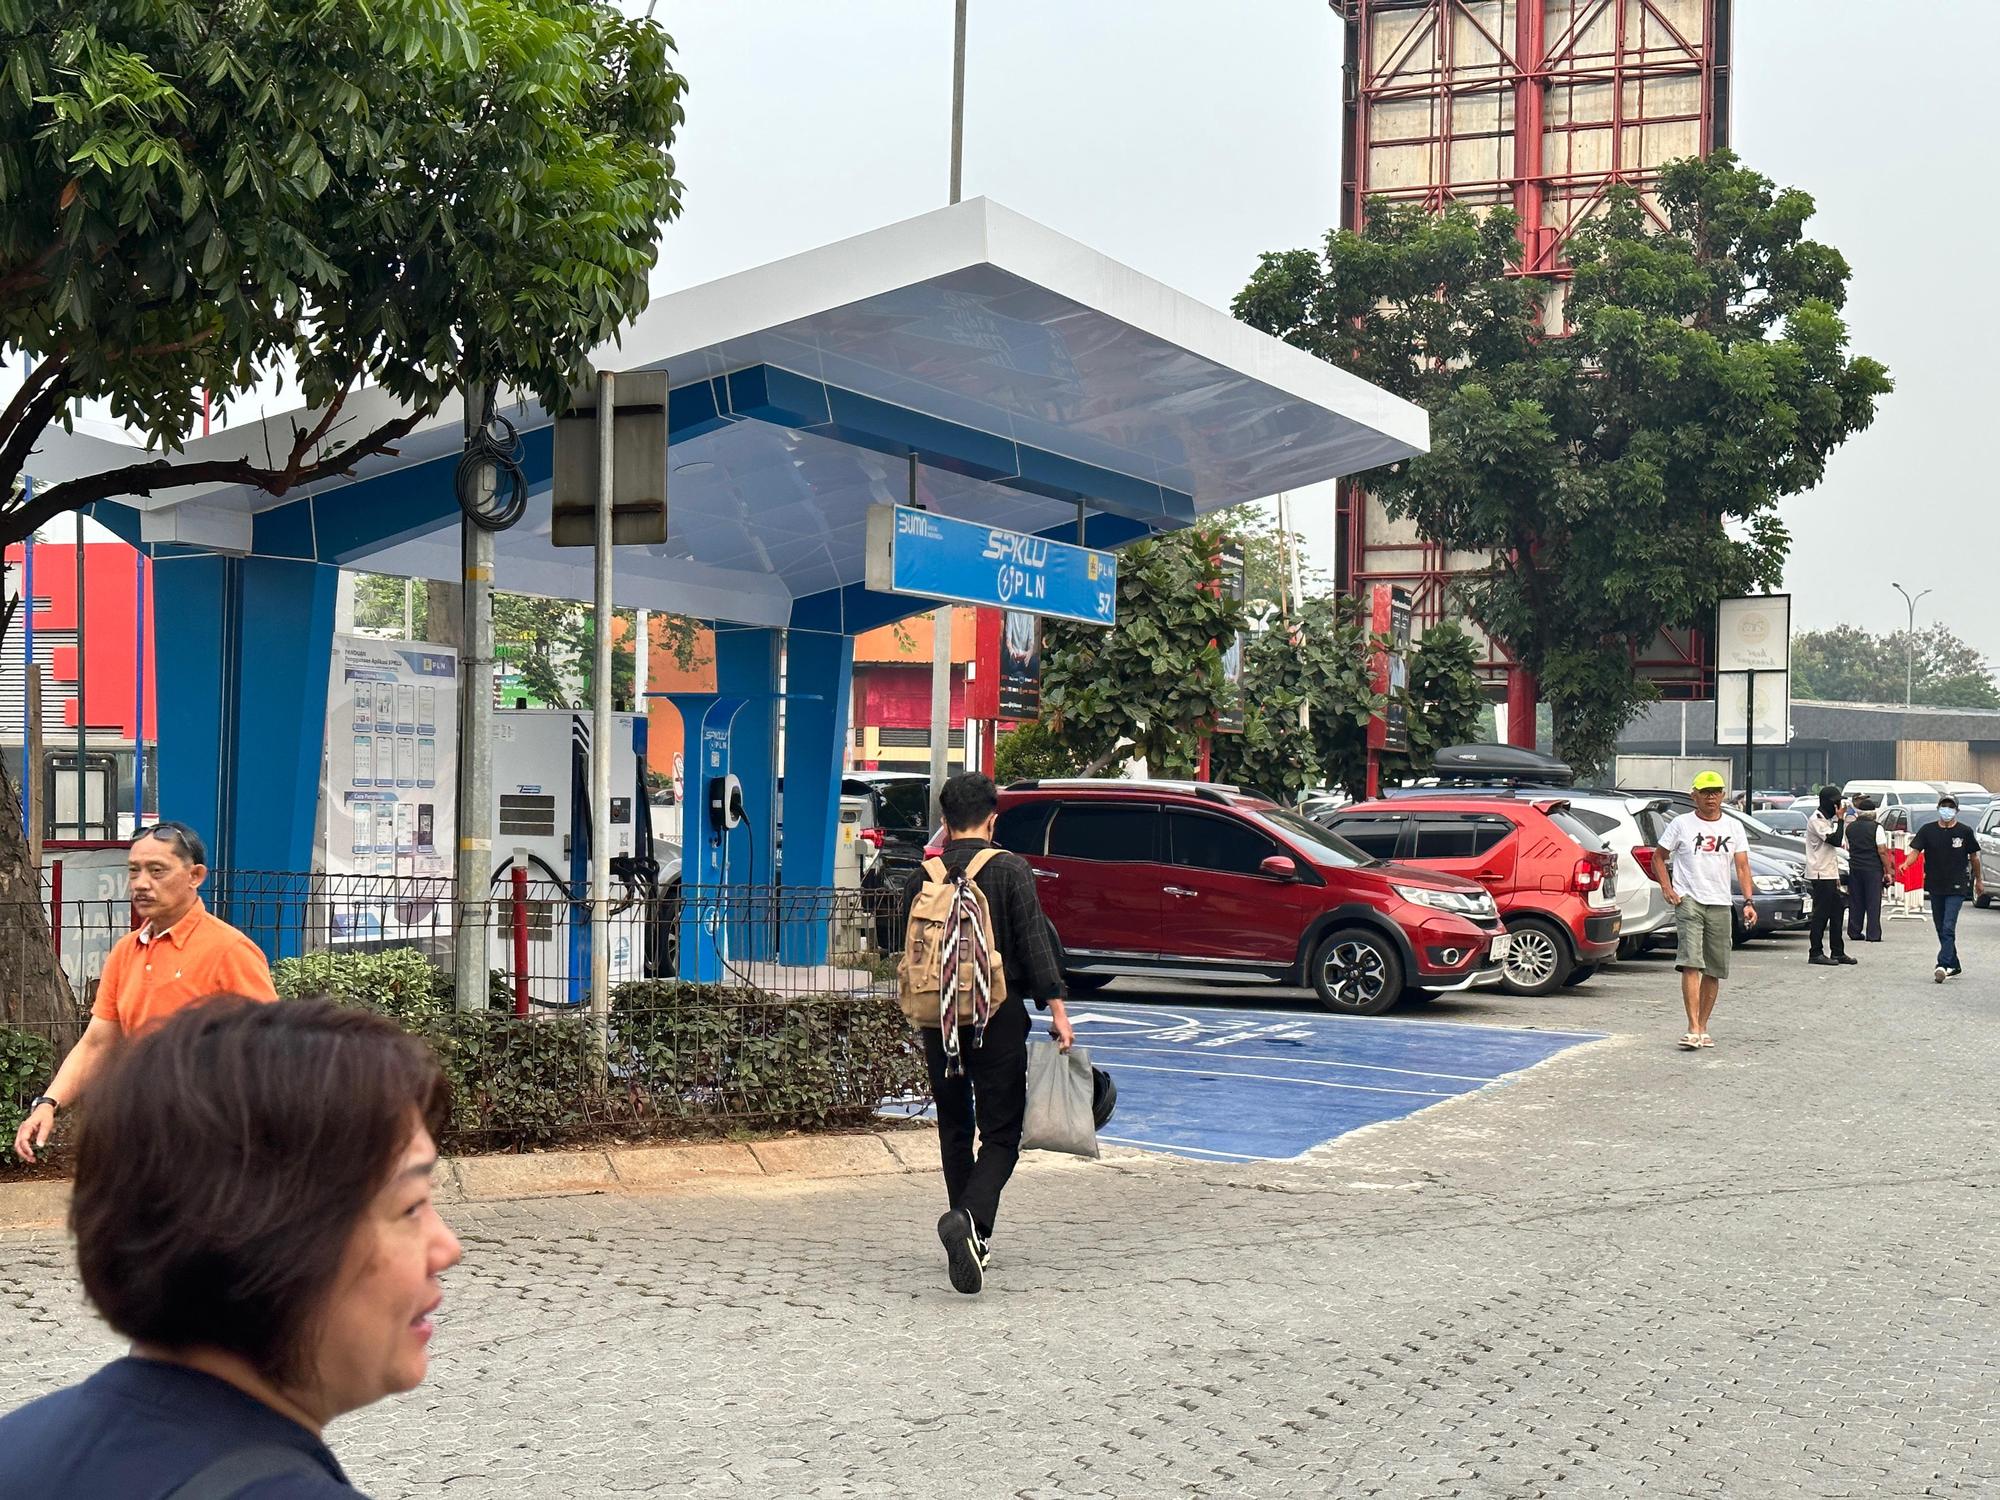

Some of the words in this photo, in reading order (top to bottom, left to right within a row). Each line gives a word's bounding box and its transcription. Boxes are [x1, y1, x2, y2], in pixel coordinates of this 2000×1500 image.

[982, 529, 1048, 568] SPKLU
[1098, 563, 1113, 578] PLN
[1014, 570, 1045, 599] PLN
[1097, 592, 1111, 614] 57
[432, 662, 446, 670] PLN
[715, 742, 728, 750] PLN
